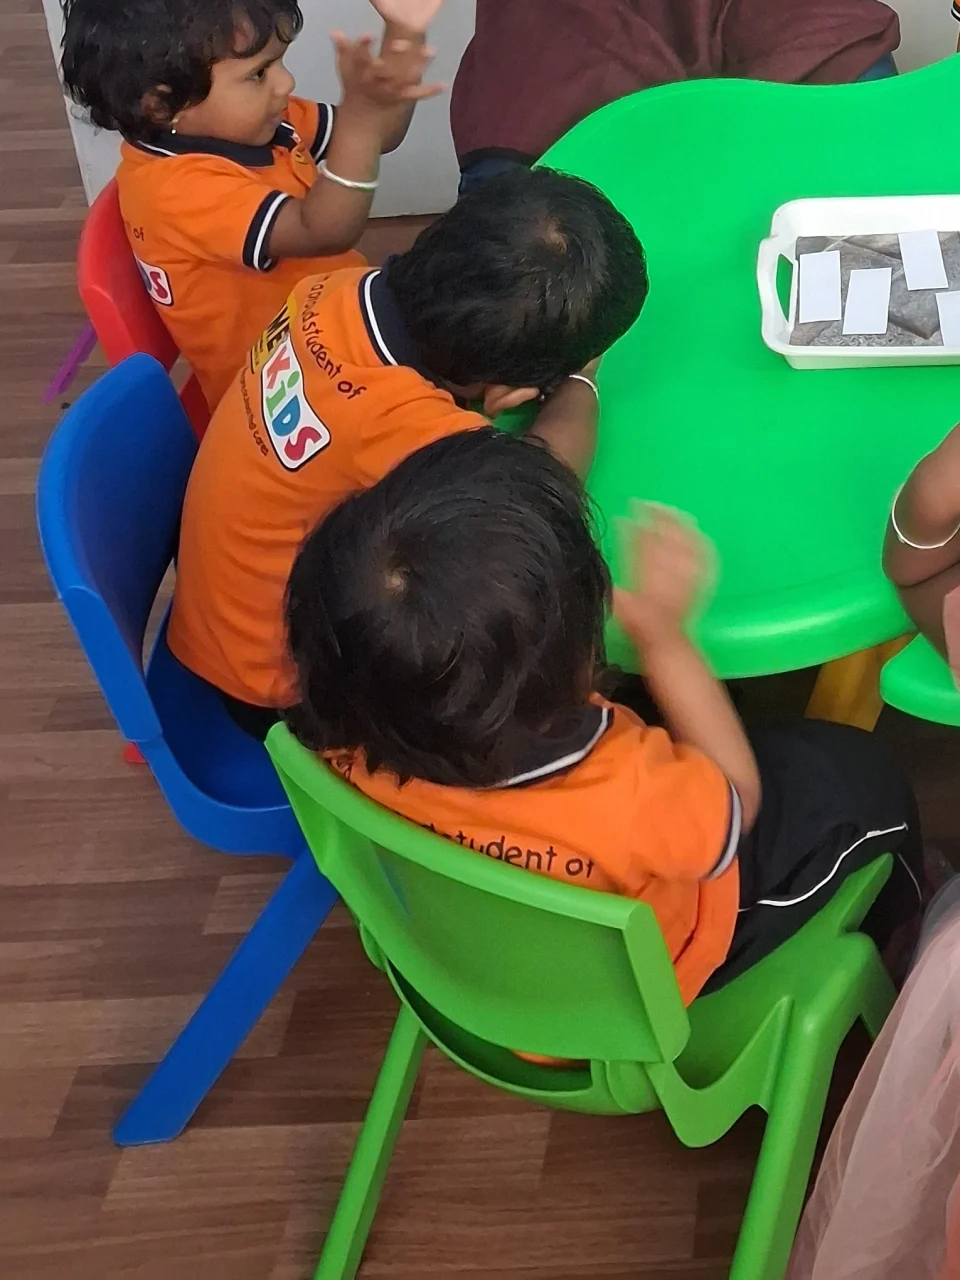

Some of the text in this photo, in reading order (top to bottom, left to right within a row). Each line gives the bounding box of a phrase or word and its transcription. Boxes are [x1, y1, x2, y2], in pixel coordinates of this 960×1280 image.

[265, 343, 323, 462] KiDS
[302, 321, 342, 380] student
[337, 380, 367, 400] of
